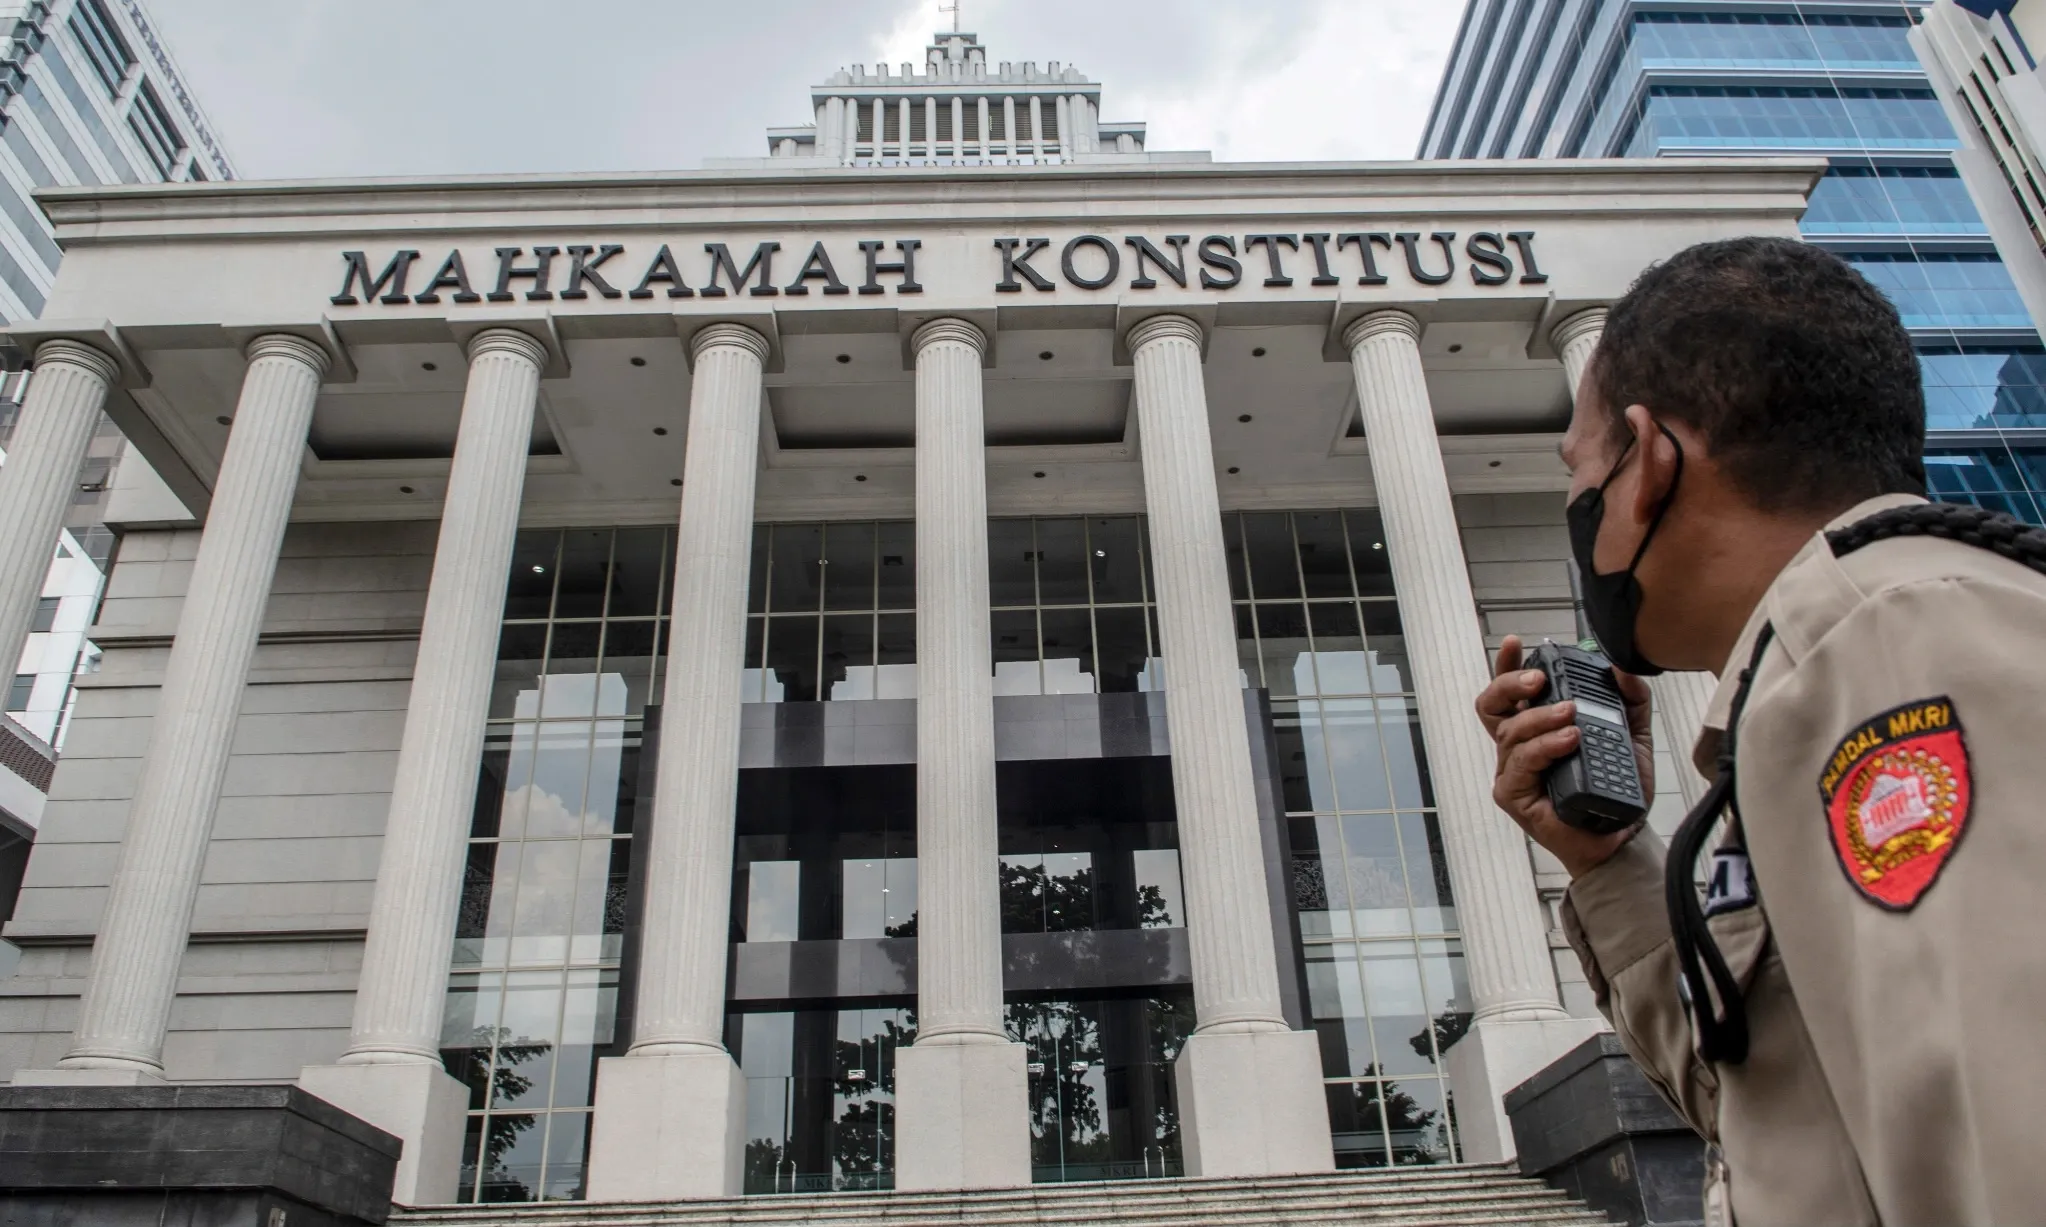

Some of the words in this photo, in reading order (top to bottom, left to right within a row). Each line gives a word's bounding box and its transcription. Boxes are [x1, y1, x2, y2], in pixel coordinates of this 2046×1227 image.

[330, 239, 923, 306] MAHKAMAH
[994, 231, 1549, 293] KONSTITUSI
[1888, 703, 1951, 739] MKRI
